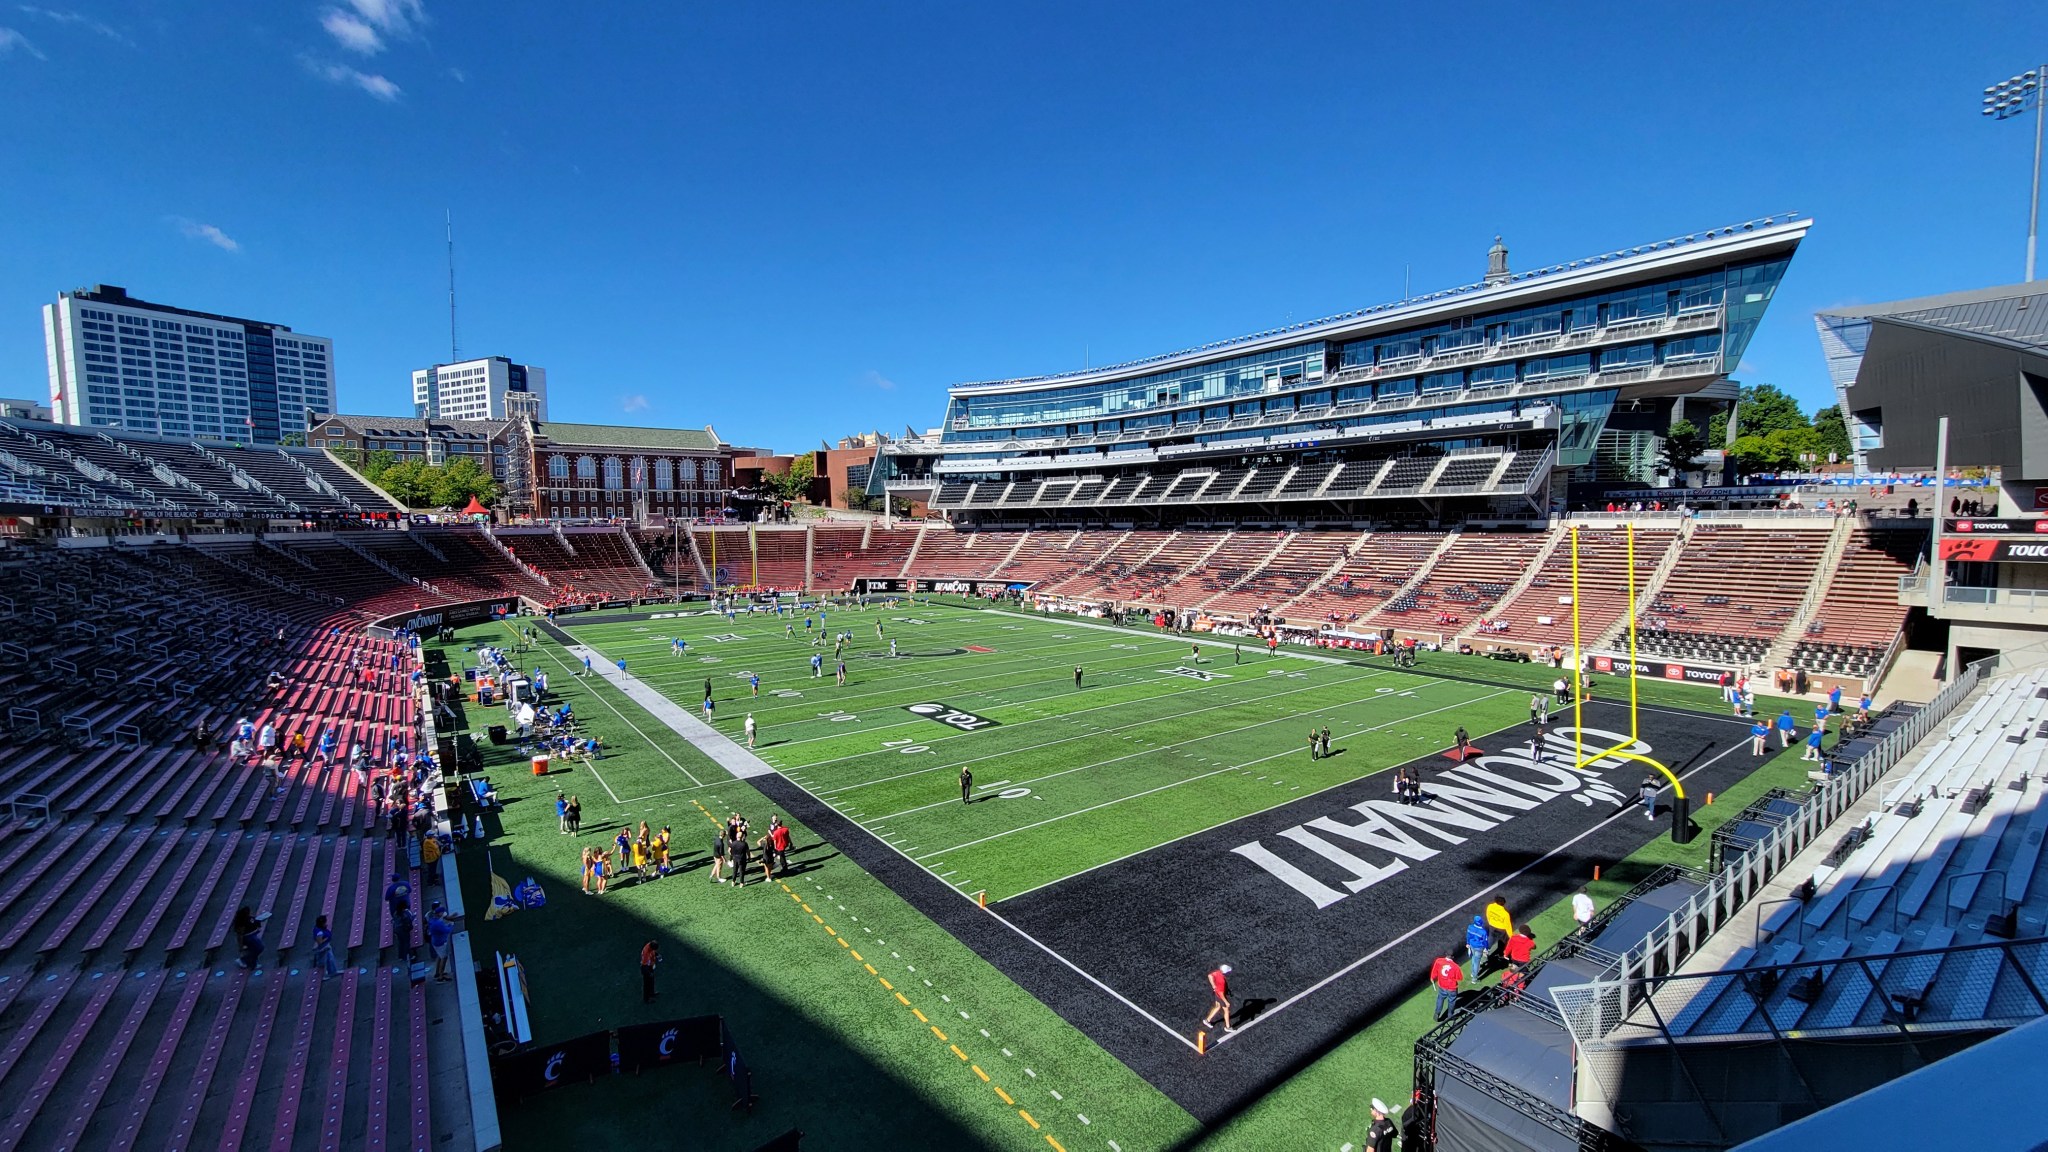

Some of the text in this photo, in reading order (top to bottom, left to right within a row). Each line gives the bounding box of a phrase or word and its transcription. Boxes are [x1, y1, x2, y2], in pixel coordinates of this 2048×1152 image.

[2008, 545, 2048, 556] TOUC
[935, 581, 970, 592] BEARCATS
[407, 613, 443, 630] CINCINNATI
[935, 709, 990, 731] TQL
[881, 738, 930, 754] 20
[976, 779, 1032, 799] 10
